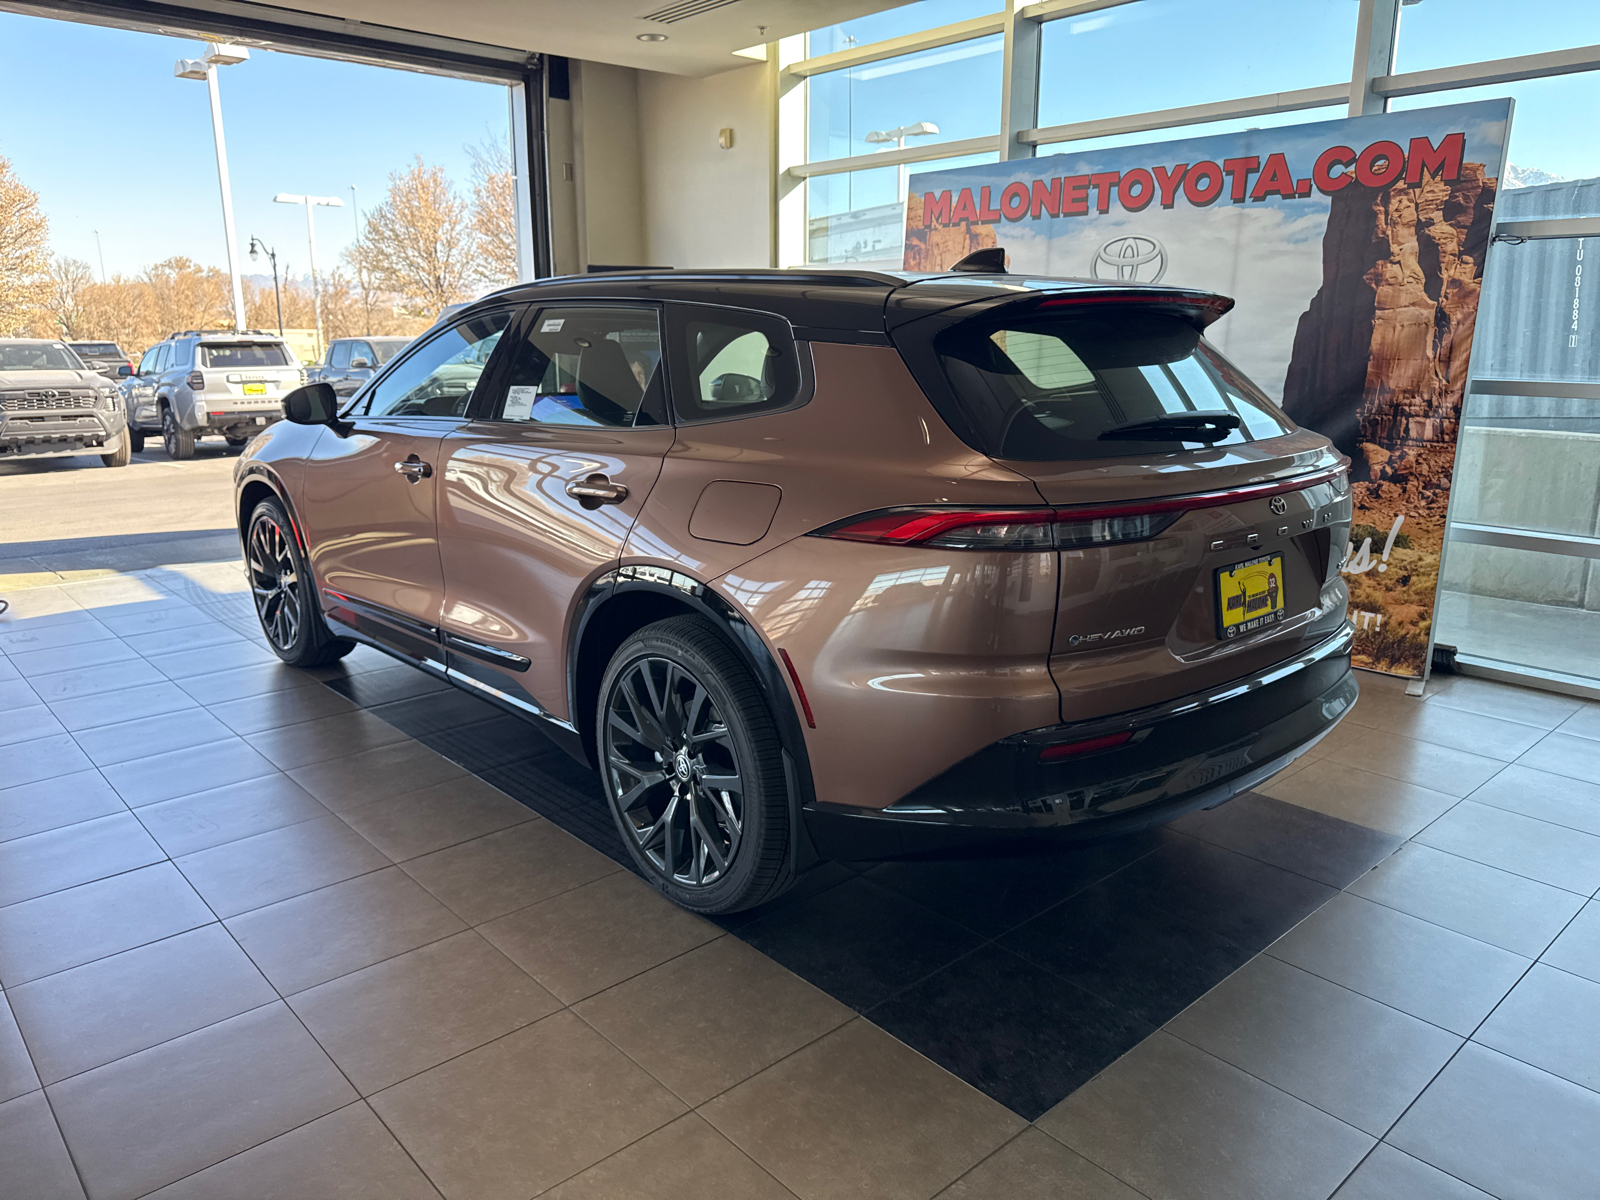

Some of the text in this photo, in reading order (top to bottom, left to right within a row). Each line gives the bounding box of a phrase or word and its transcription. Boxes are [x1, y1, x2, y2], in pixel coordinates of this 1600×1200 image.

[923, 132, 1467, 228] MALONETOYOTA.COM
[1571, 264, 1583, 331] 081884
[1210, 512, 1332, 550] CROWN
[1268, 577, 1276, 588] 32
[1246, 594, 1269, 614] MALONE
[1239, 614, 1275, 632] WE MAKE IT EASY
[655, 637, 696, 660] TURANZA
